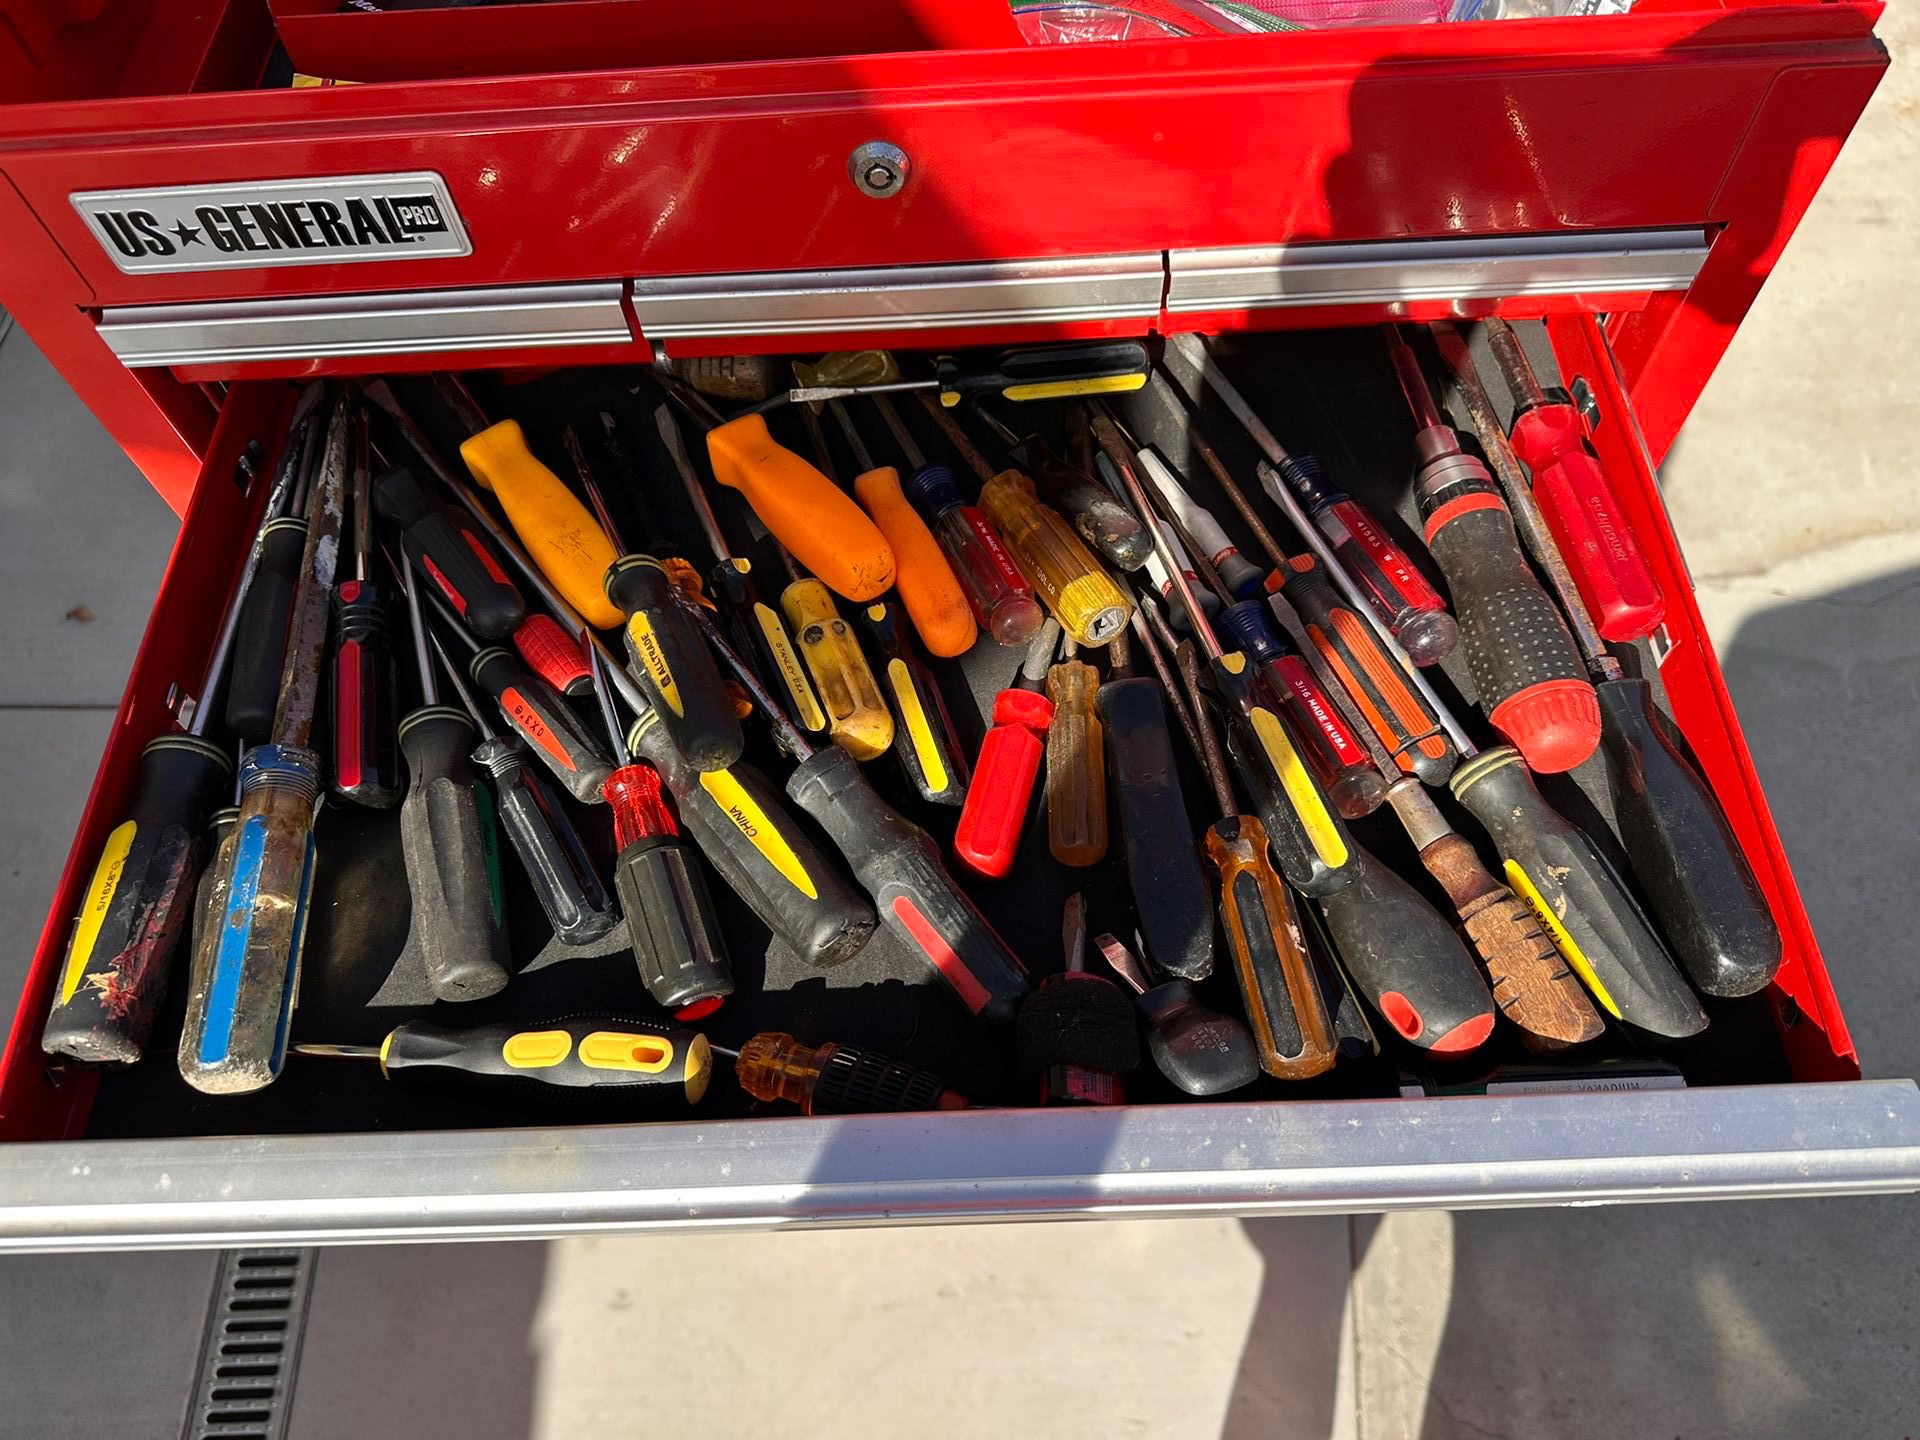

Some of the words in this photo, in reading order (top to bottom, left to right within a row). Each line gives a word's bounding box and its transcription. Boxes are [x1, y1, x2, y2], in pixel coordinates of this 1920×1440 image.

[94, 210, 177, 258] US
[194, 196, 416, 253] GENERAL
[400, 203, 440, 228] PRO
[985, 535, 1000, 552] MADE
[1002, 562, 1015, 576] USA
[1035, 566, 1049, 587] TOOL
[640, 632, 666, 676] ALLTRADE
[776, 642, 797, 676] STANLEY
[793, 677, 805, 694] USA
[1294, 680, 1311, 698] 3/16
[1307, 698, 1329, 723] MADE
[1323, 721, 1335, 732] IN
[1330, 731, 1347, 750] USA
[729, 804, 758, 837] CHINA
